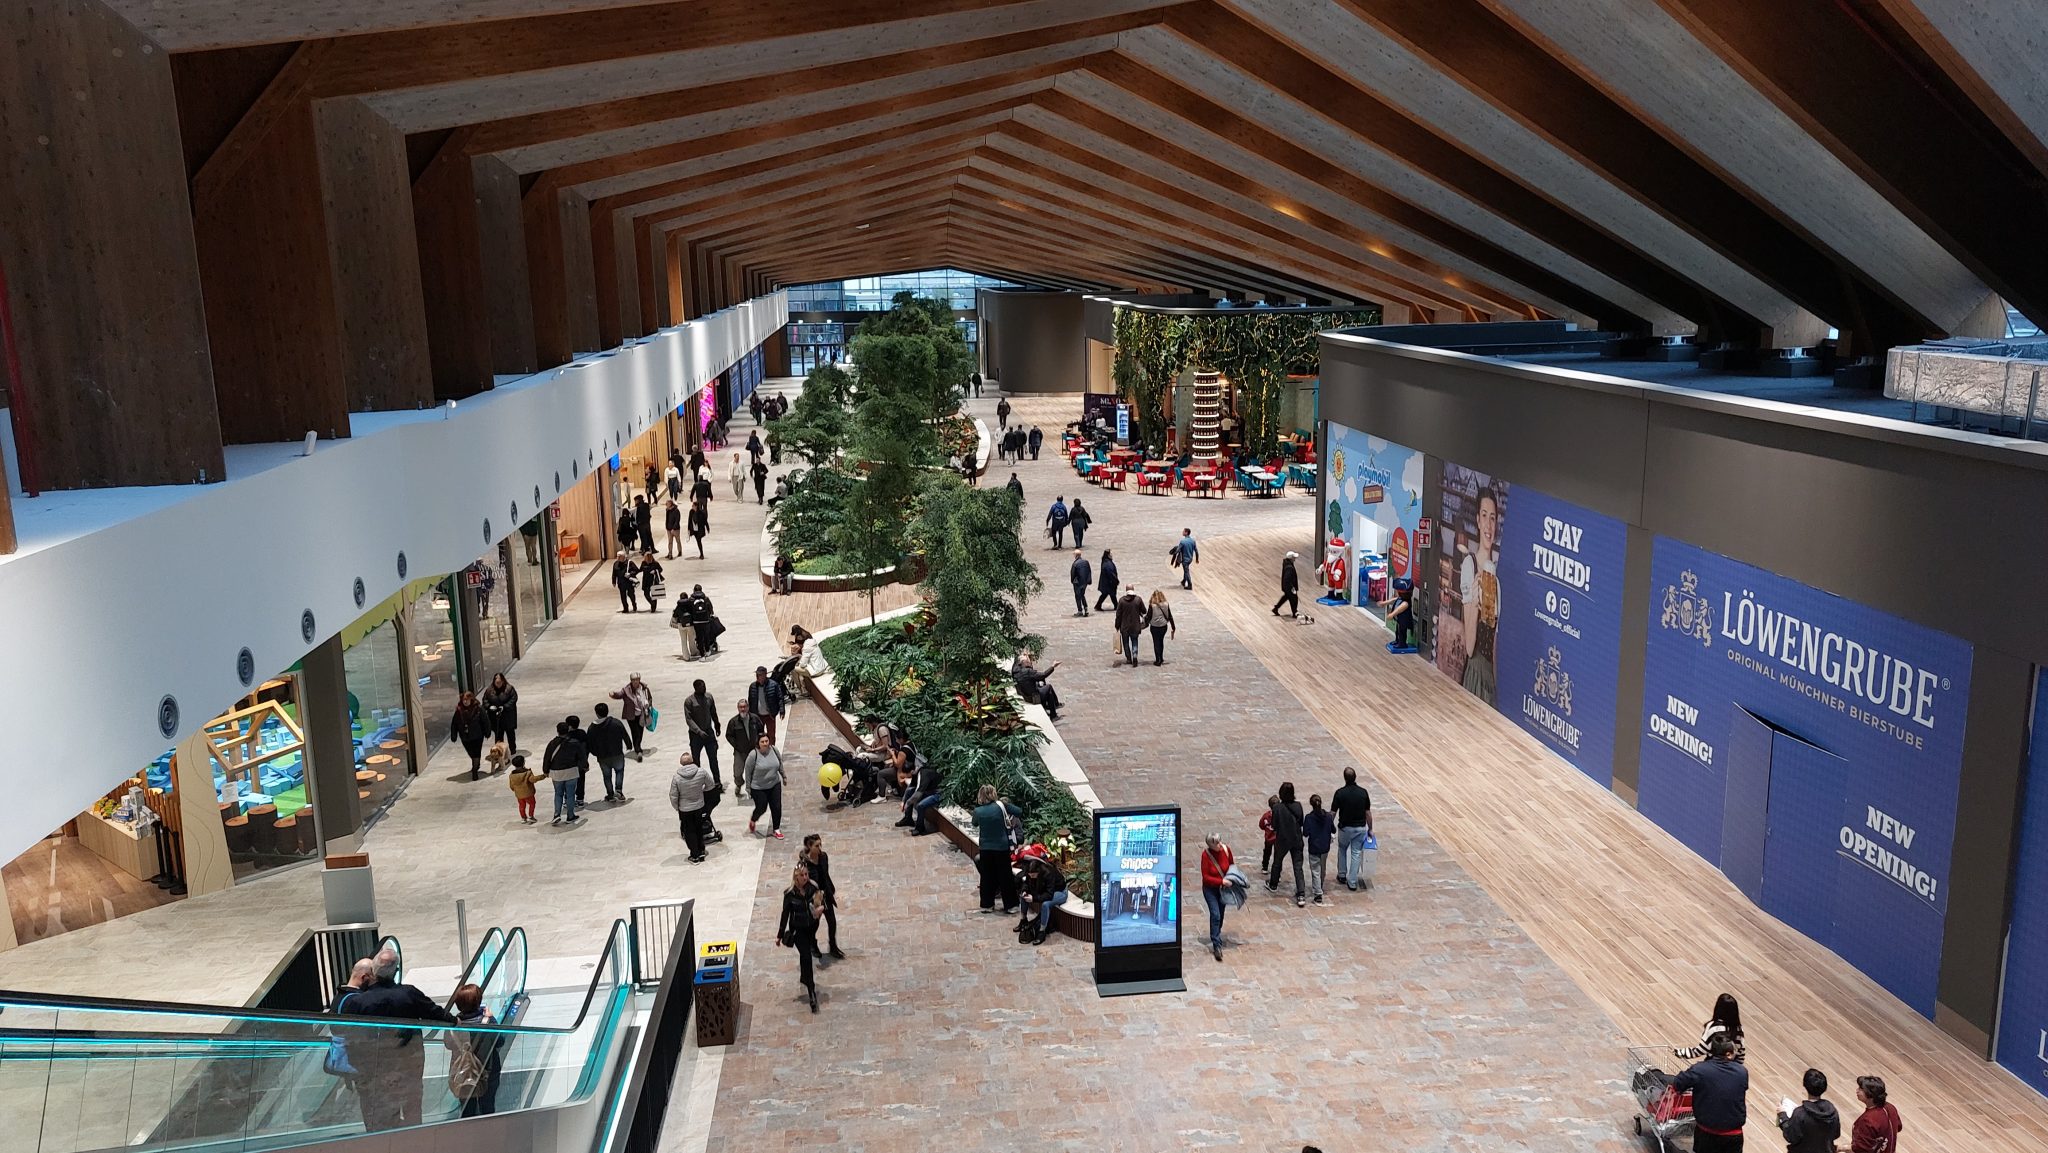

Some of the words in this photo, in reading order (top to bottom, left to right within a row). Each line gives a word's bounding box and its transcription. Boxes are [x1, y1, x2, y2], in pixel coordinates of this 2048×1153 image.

[1357, 462, 1391, 487] playmobil
[1543, 516, 1583, 553] STAY
[1532, 543, 1591, 592] TUNED!
[1666, 694, 1699, 726] NEW
[1727, 649, 1776, 680] ORIGINAL
[1779, 673, 1845, 712] MÜNCHNER
[1850, 706, 1923, 750] BIERSTUBE
[1650, 713, 1713, 765] OPENING!
[1866, 805, 1915, 849] NEW
[1840, 826, 1937, 901] OPENING!
